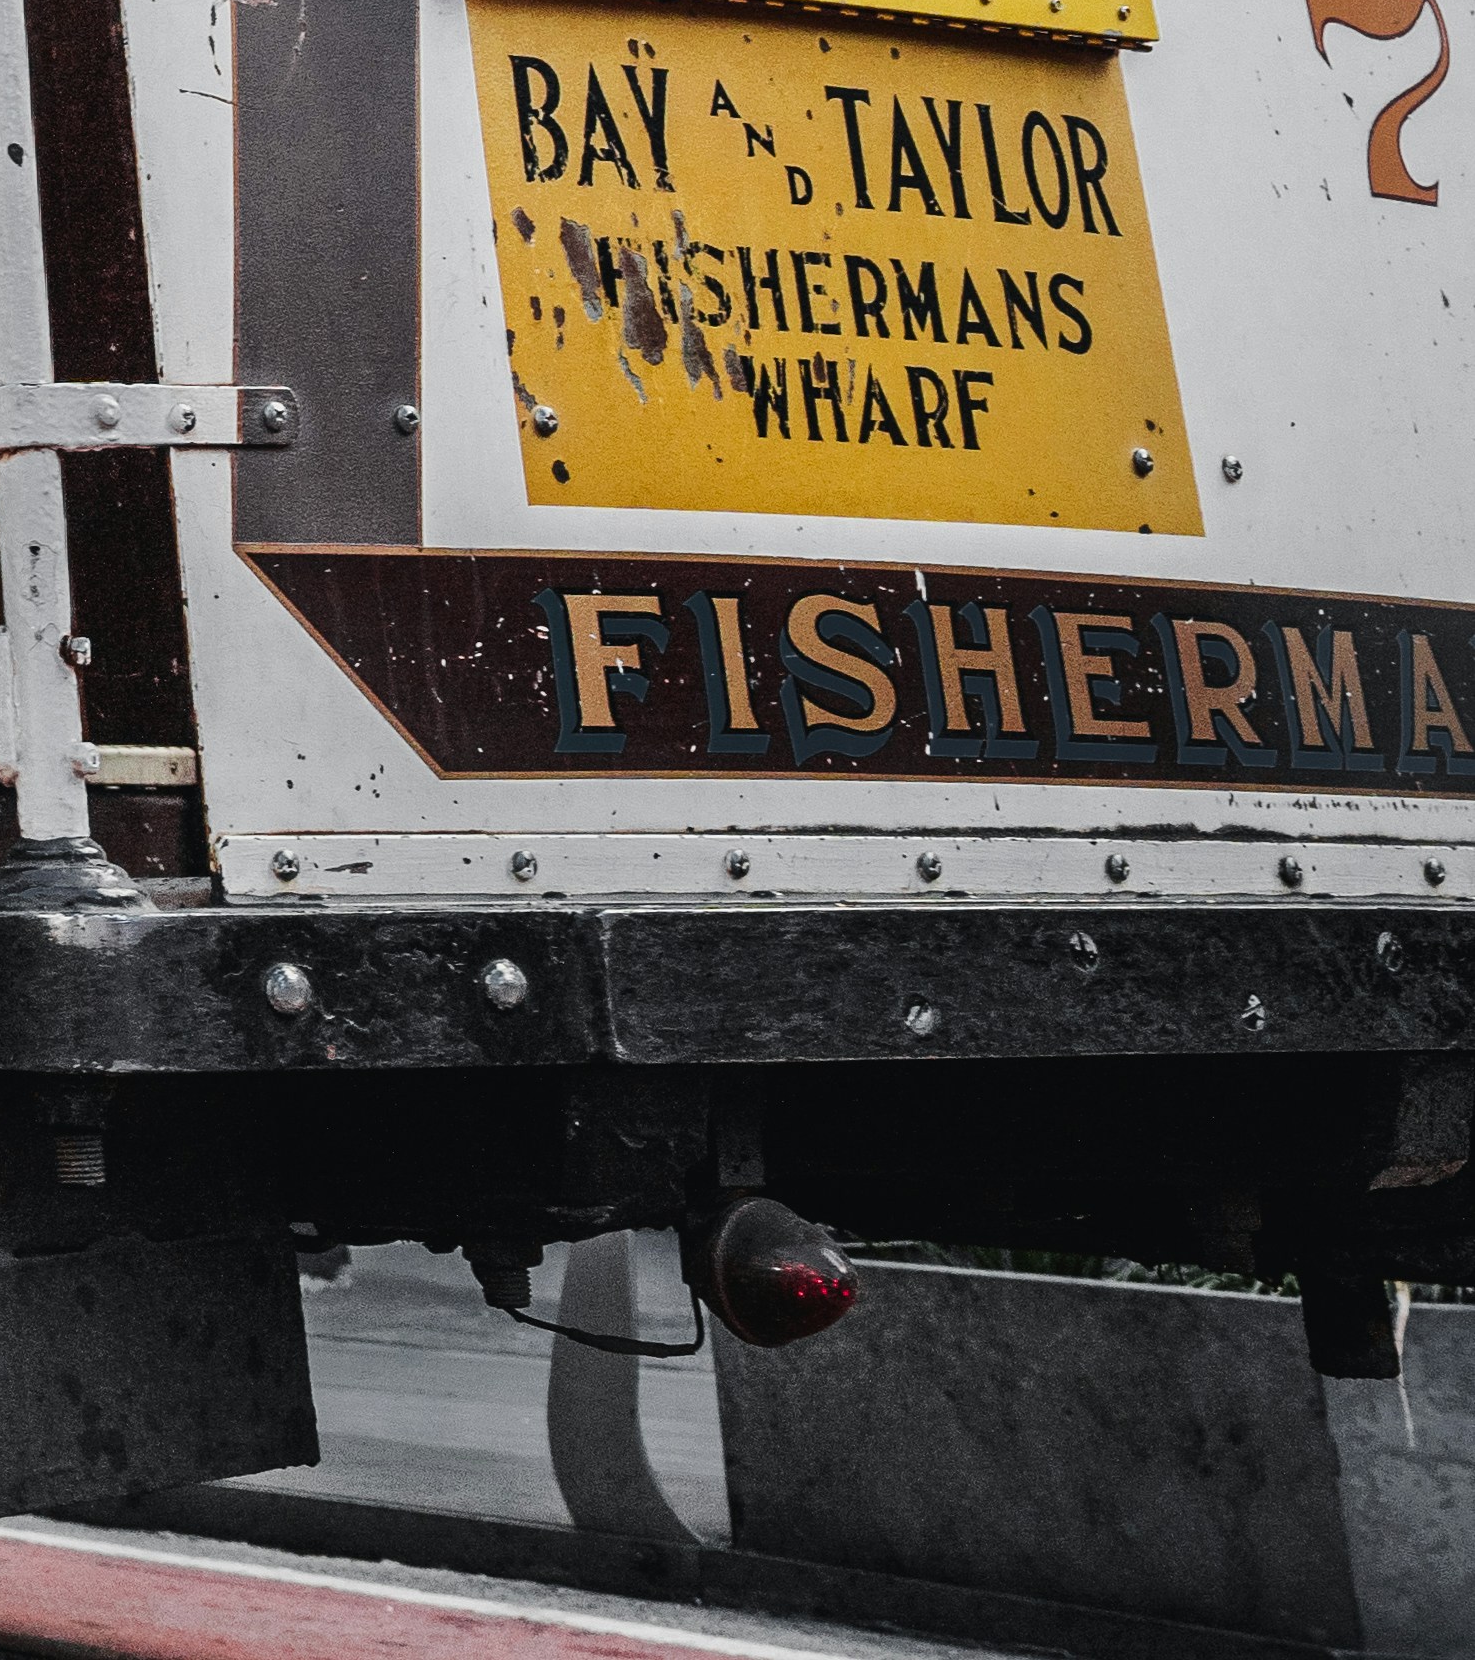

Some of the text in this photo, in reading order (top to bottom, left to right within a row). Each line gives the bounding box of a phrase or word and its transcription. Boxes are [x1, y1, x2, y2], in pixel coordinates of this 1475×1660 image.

[508, 55, 1123, 237] BAY AND TAYLOR
[594, 233, 1093, 355] FISHERMANS
[739, 352, 994, 450] WHARF
